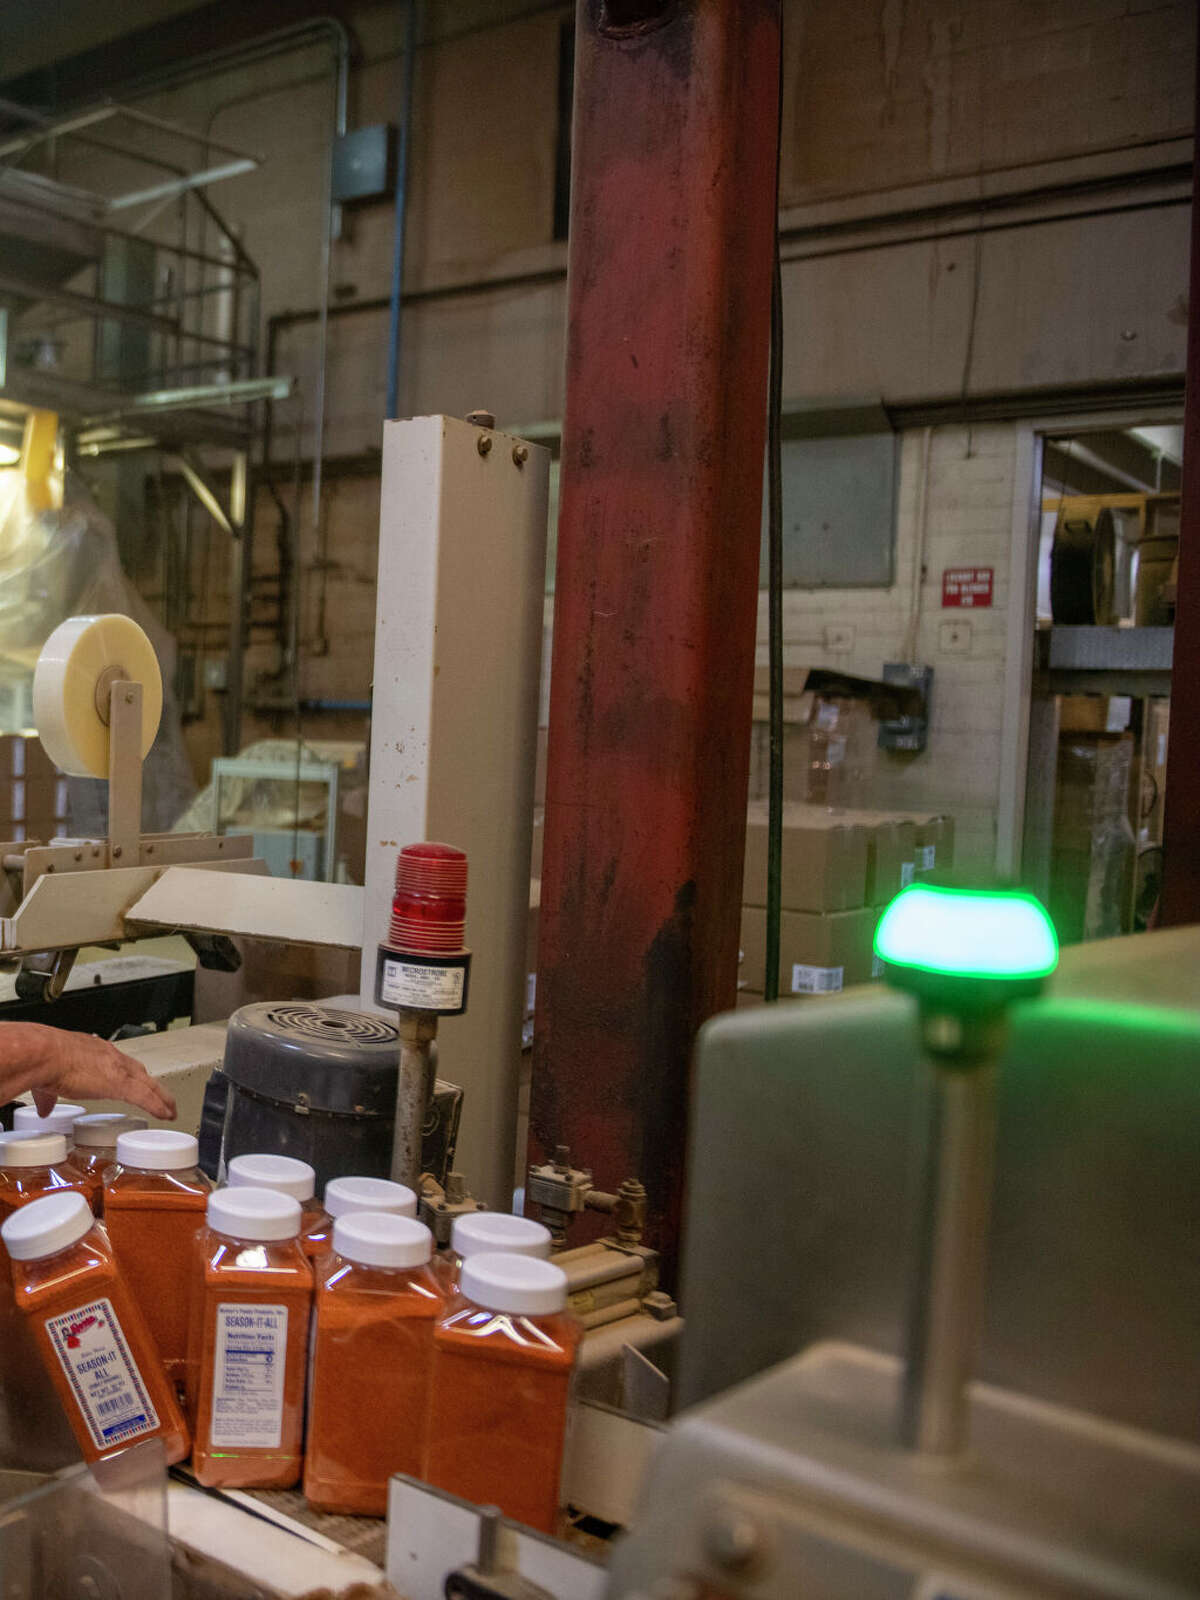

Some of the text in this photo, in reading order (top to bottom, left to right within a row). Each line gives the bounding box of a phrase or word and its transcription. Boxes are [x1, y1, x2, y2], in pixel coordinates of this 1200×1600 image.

[225, 1316, 278, 1329] SEASON-IT-ALL
[257, 1333, 274, 1341] Facts
[76, 1351, 117, 1375] SEASON-IT
[94, 1367, 109, 1380] ALL
